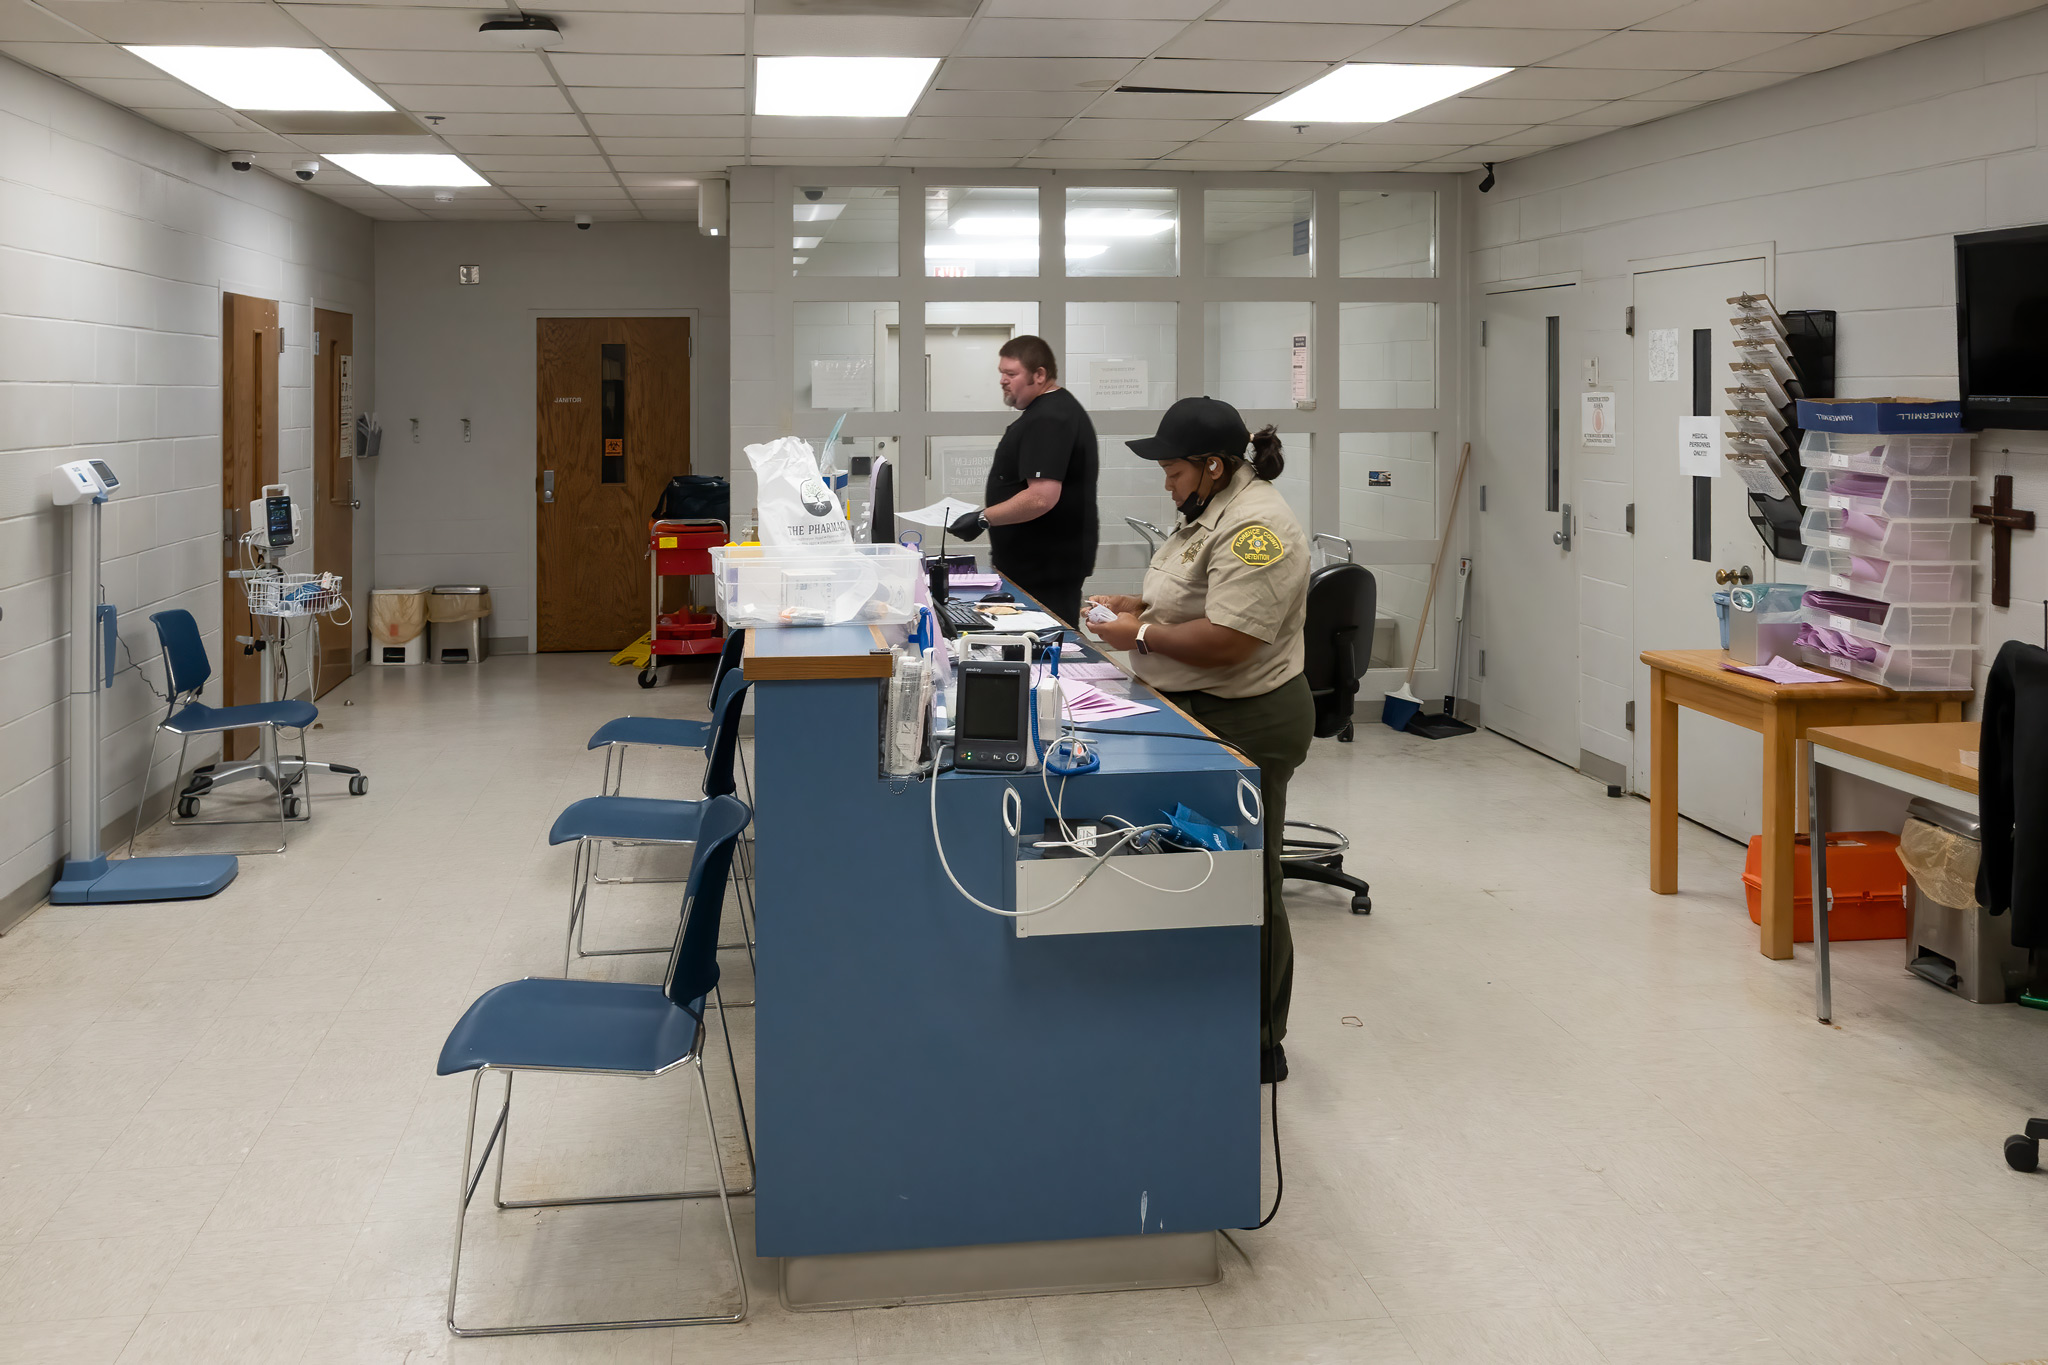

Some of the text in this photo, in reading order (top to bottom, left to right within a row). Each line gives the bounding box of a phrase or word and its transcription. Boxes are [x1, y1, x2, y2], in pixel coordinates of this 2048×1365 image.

[1816, 413, 1854, 422] HAMMERMILL
[1897, 411, 1961, 420] AMMERMILL
[788, 525, 804, 536] THE
[1235, 528, 1281, 550] FLORENCE COUNTY
